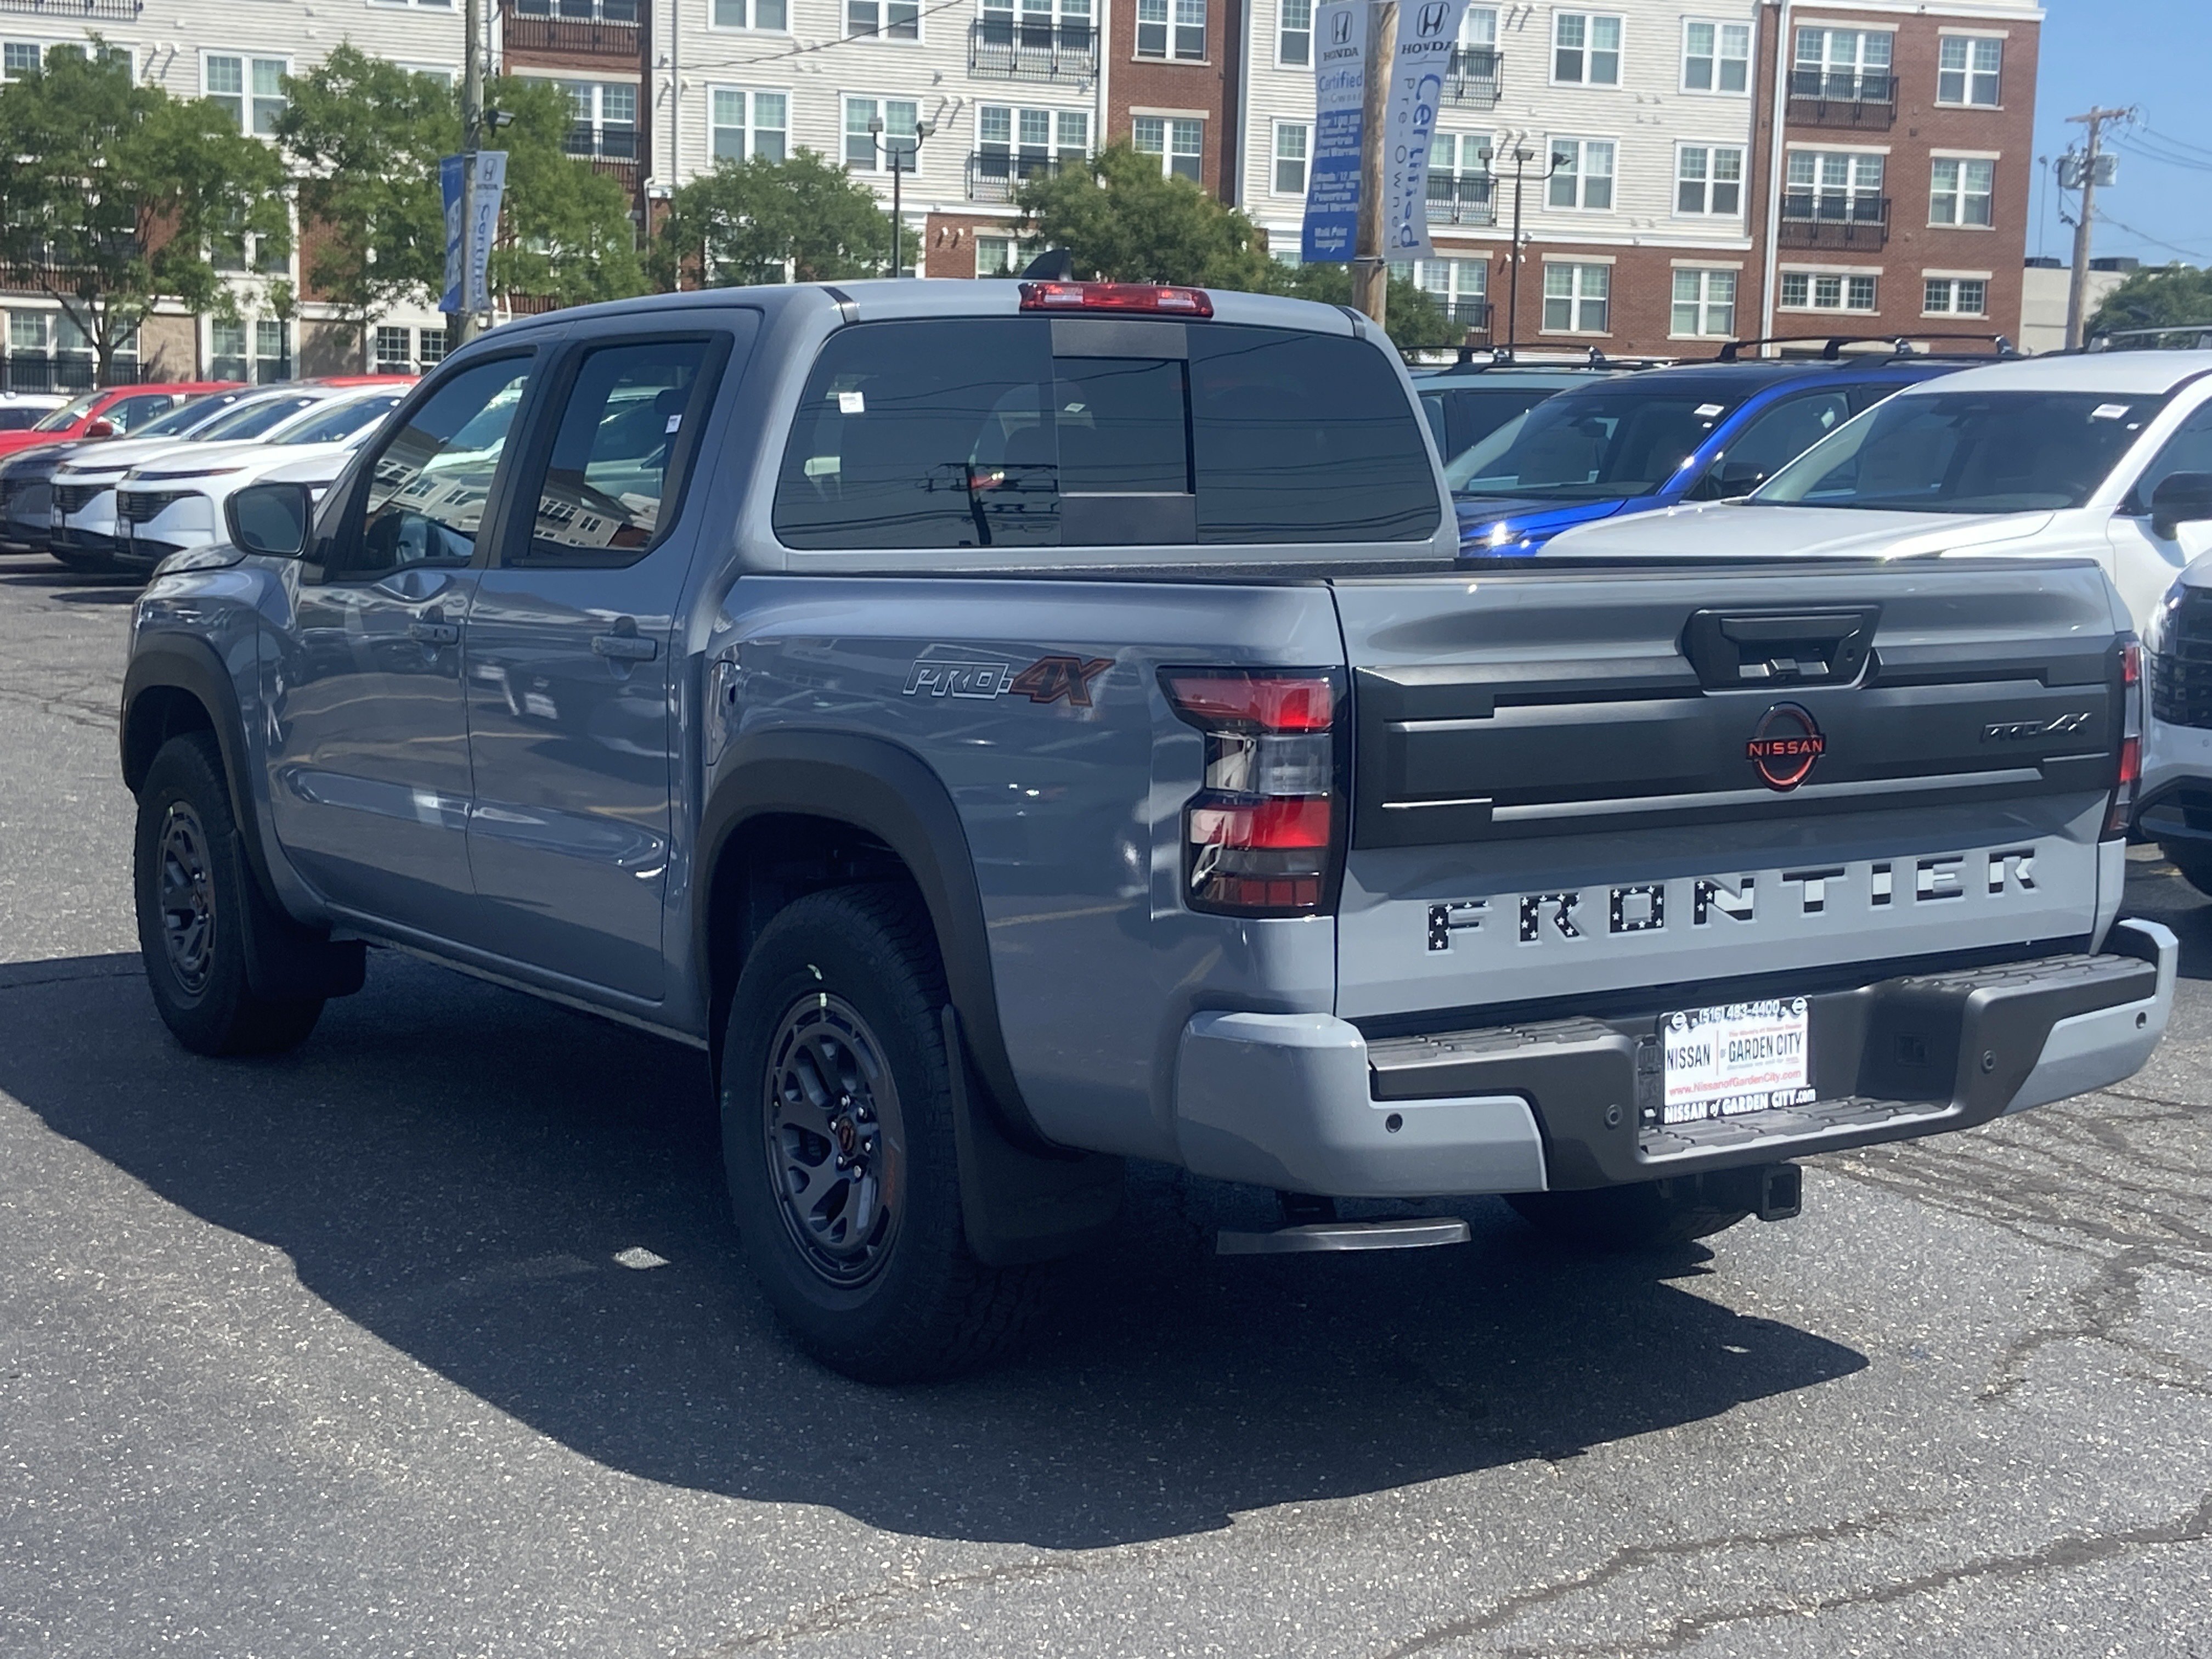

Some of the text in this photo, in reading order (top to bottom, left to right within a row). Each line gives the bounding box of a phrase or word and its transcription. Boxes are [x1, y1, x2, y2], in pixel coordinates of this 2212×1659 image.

[1402, 41, 1452, 54] HONDA
[1319, 70, 1363, 93] Certified
[1401, 74, 1442, 247] Certified
[902, 655, 1116, 707] PRO-4X
[1748, 739, 1823, 757] NISSAN
[1426, 848, 2036, 952] FRONTIER
[1667, 1043, 1711, 1071] NISSAN
[1729, 1034, 1773, 1062] GARDEN
[1776, 1031, 1802, 1056] CITY
[1664, 1101, 1707, 1124] NISSAN
[1722, 1093, 1768, 1115] GARDEN
